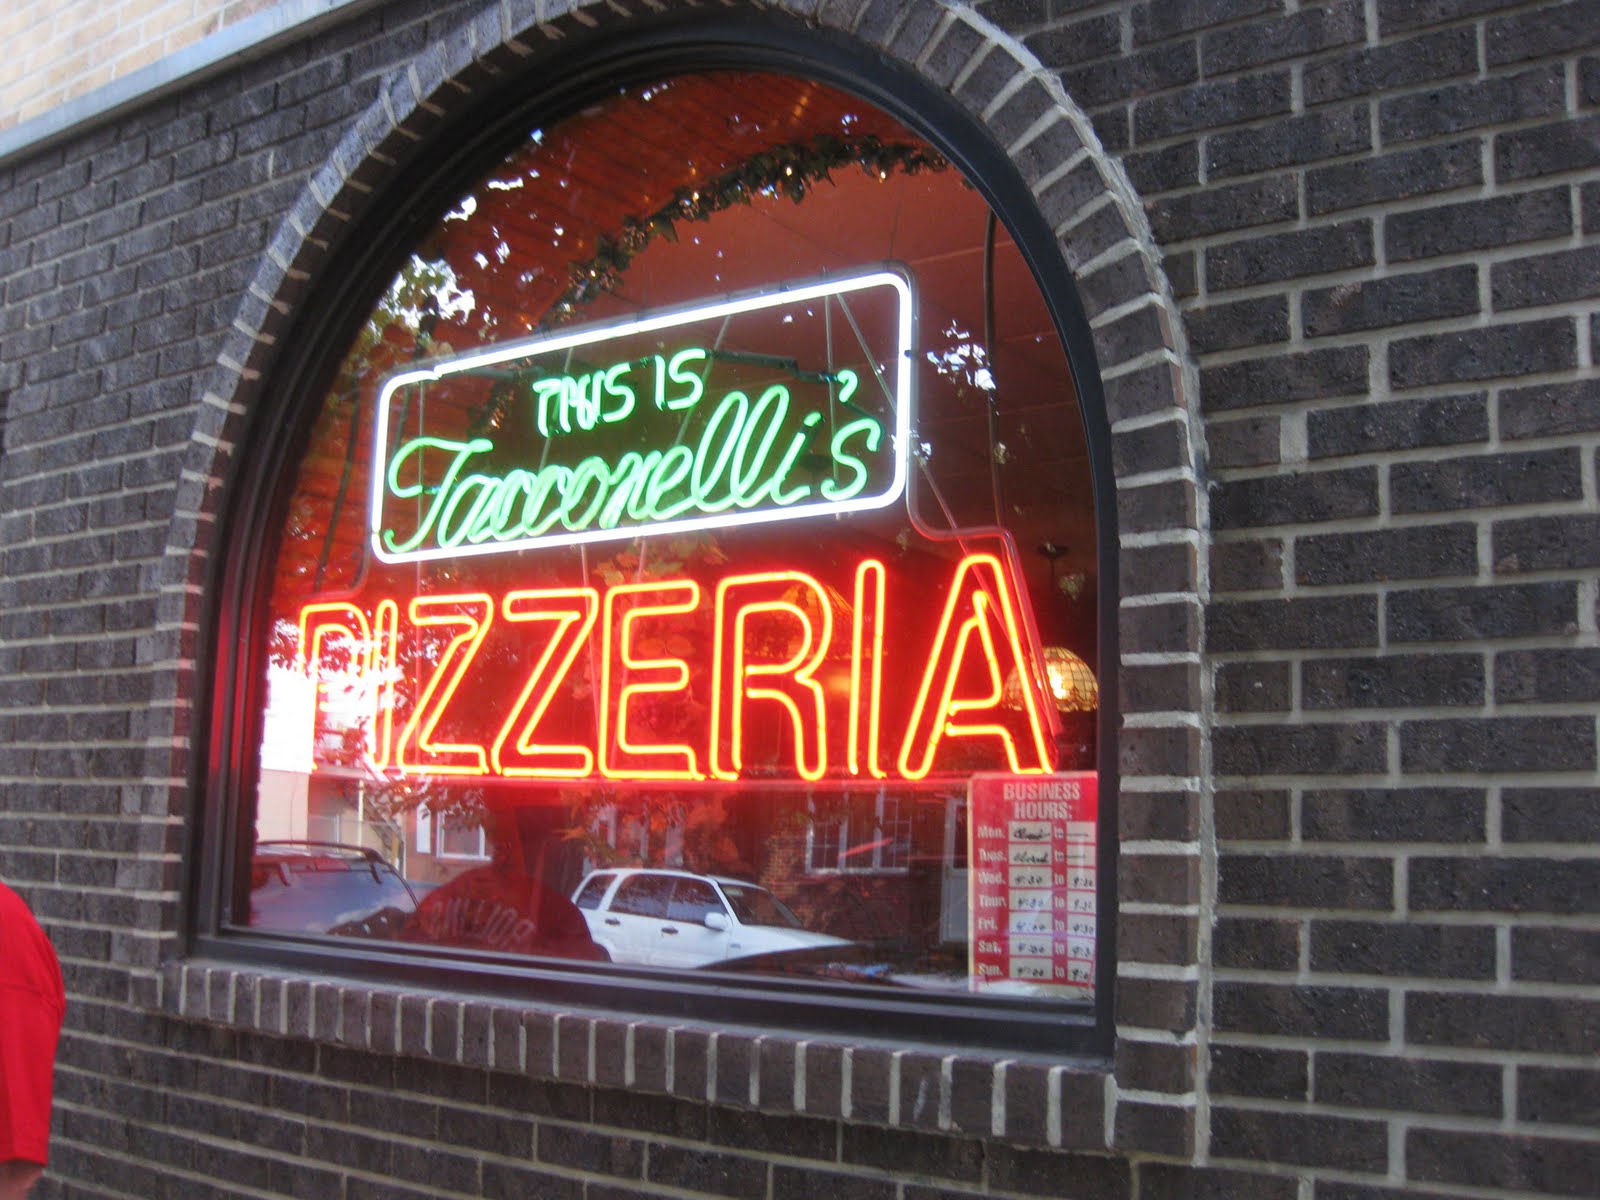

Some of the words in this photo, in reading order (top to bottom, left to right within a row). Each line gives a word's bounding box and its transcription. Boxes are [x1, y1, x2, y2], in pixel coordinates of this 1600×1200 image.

[533, 362, 636, 437] THIS
[655, 348, 706, 411] IS
[297, 552, 1054, 782] PIZZERIA
[1003, 782, 1080, 800] BUSINESS
[1014, 801, 1072, 819] HOURS:
[977, 825, 1005, 838] Mon.
[1053, 827, 1064, 838] to
[1053, 850, 1064, 862] to
[1054, 873, 1064, 885] to
[1054, 896, 1064, 908] to
[1054, 920, 1064, 931] to
[1054, 942, 1064, 955] to
[1054, 967, 1065, 978] to
